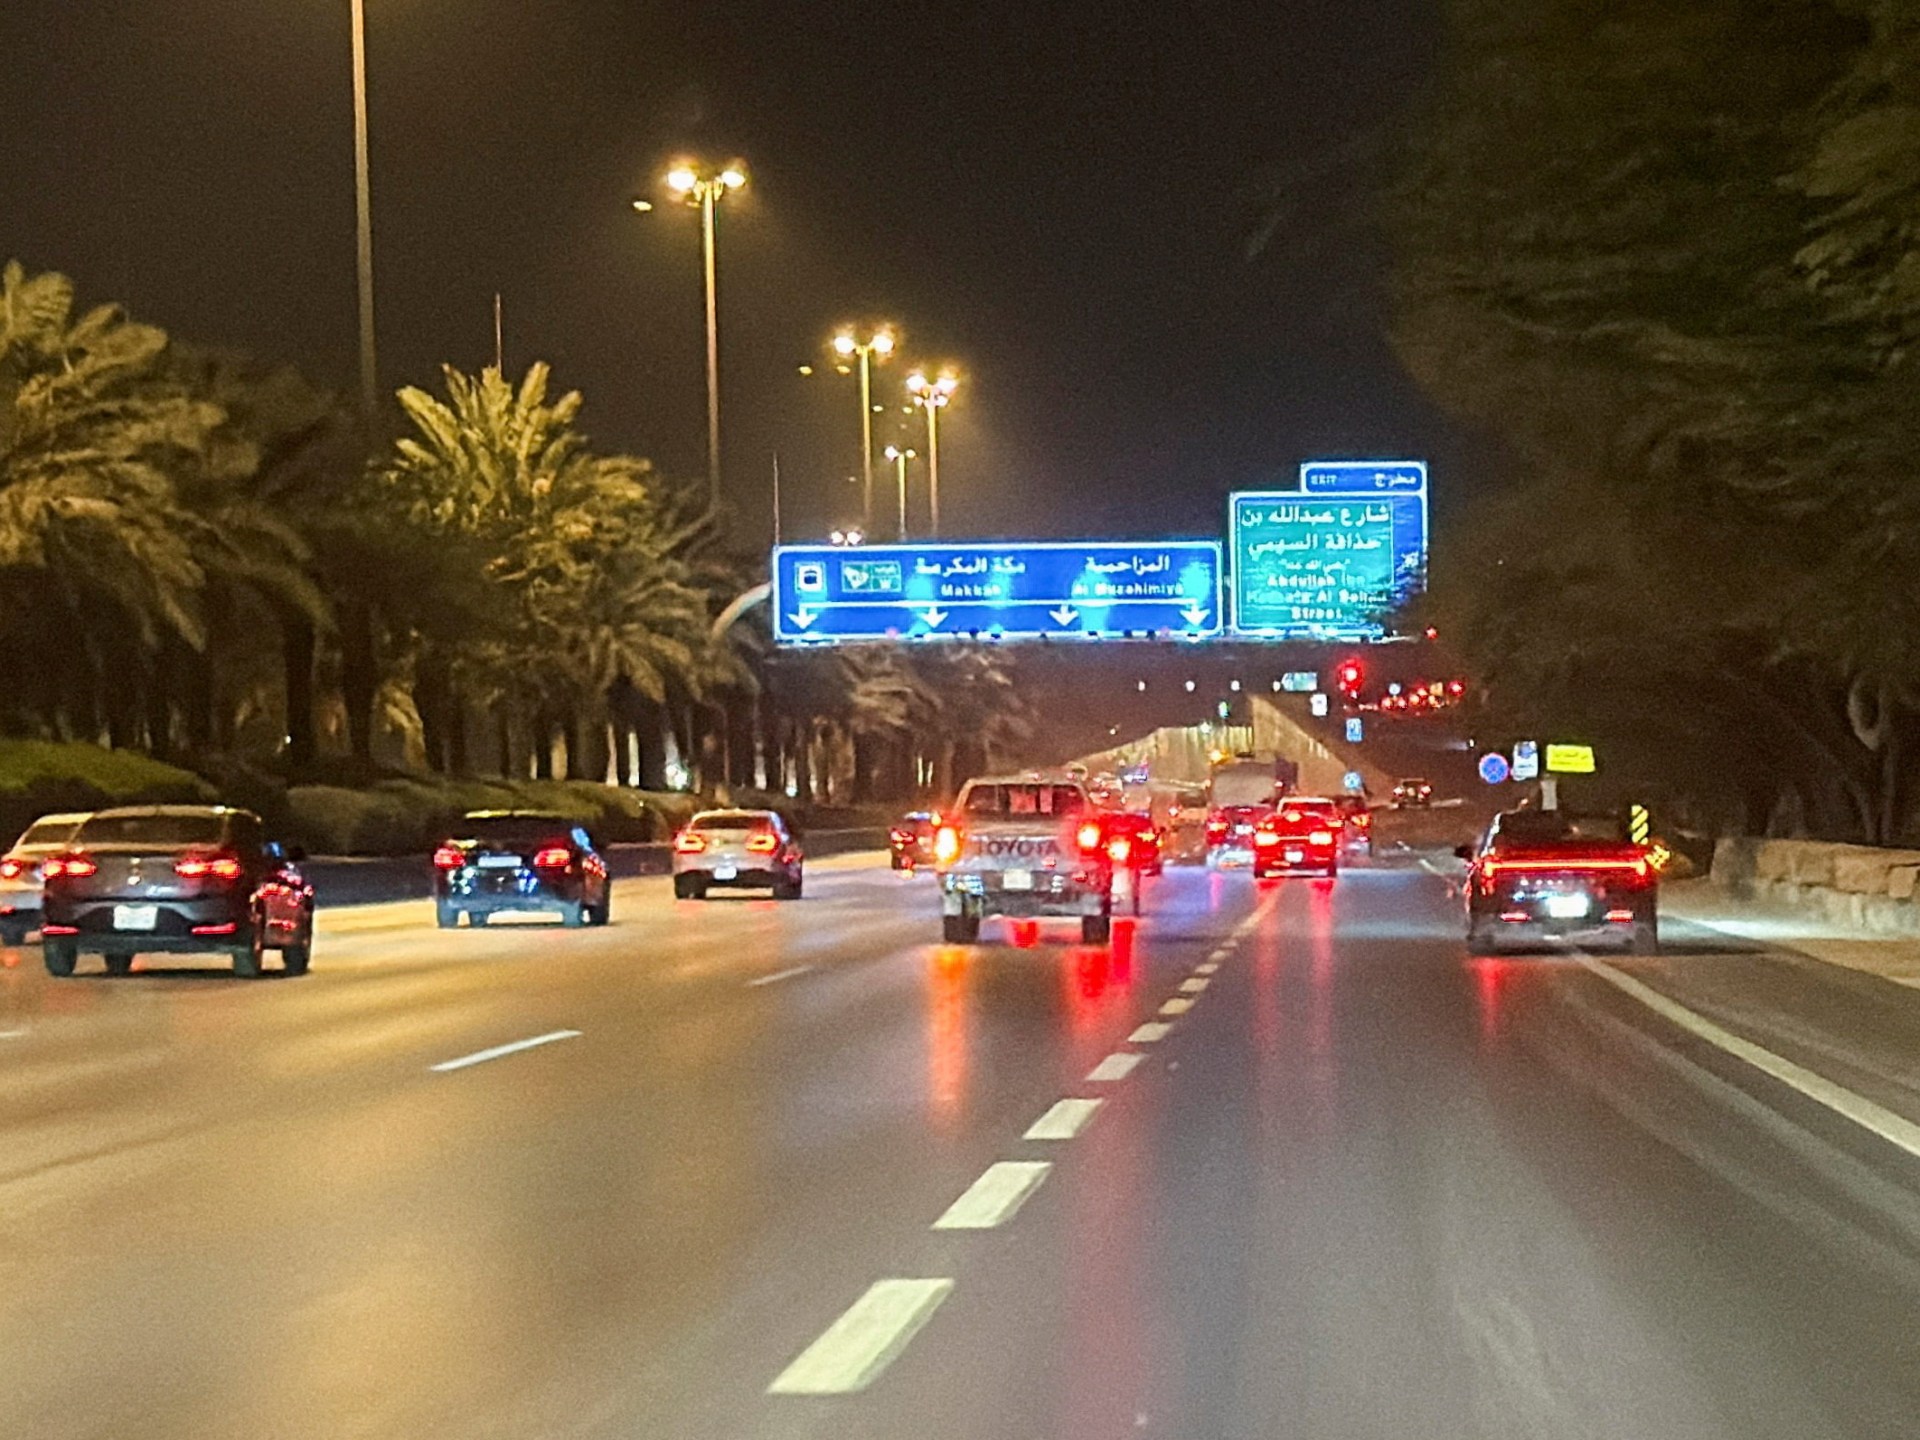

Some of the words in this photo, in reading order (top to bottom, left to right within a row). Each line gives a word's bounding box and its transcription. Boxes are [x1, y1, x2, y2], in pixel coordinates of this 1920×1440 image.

[1241, 508, 1263, 527] بن
[1340, 505, 1390, 527] شارع
[915, 556, 988, 577] المكرمة
[941, 583, 1001, 597] Makkah
[1291, 606, 1343, 620] Street
[977, 839, 1061, 857] TOYOTA
